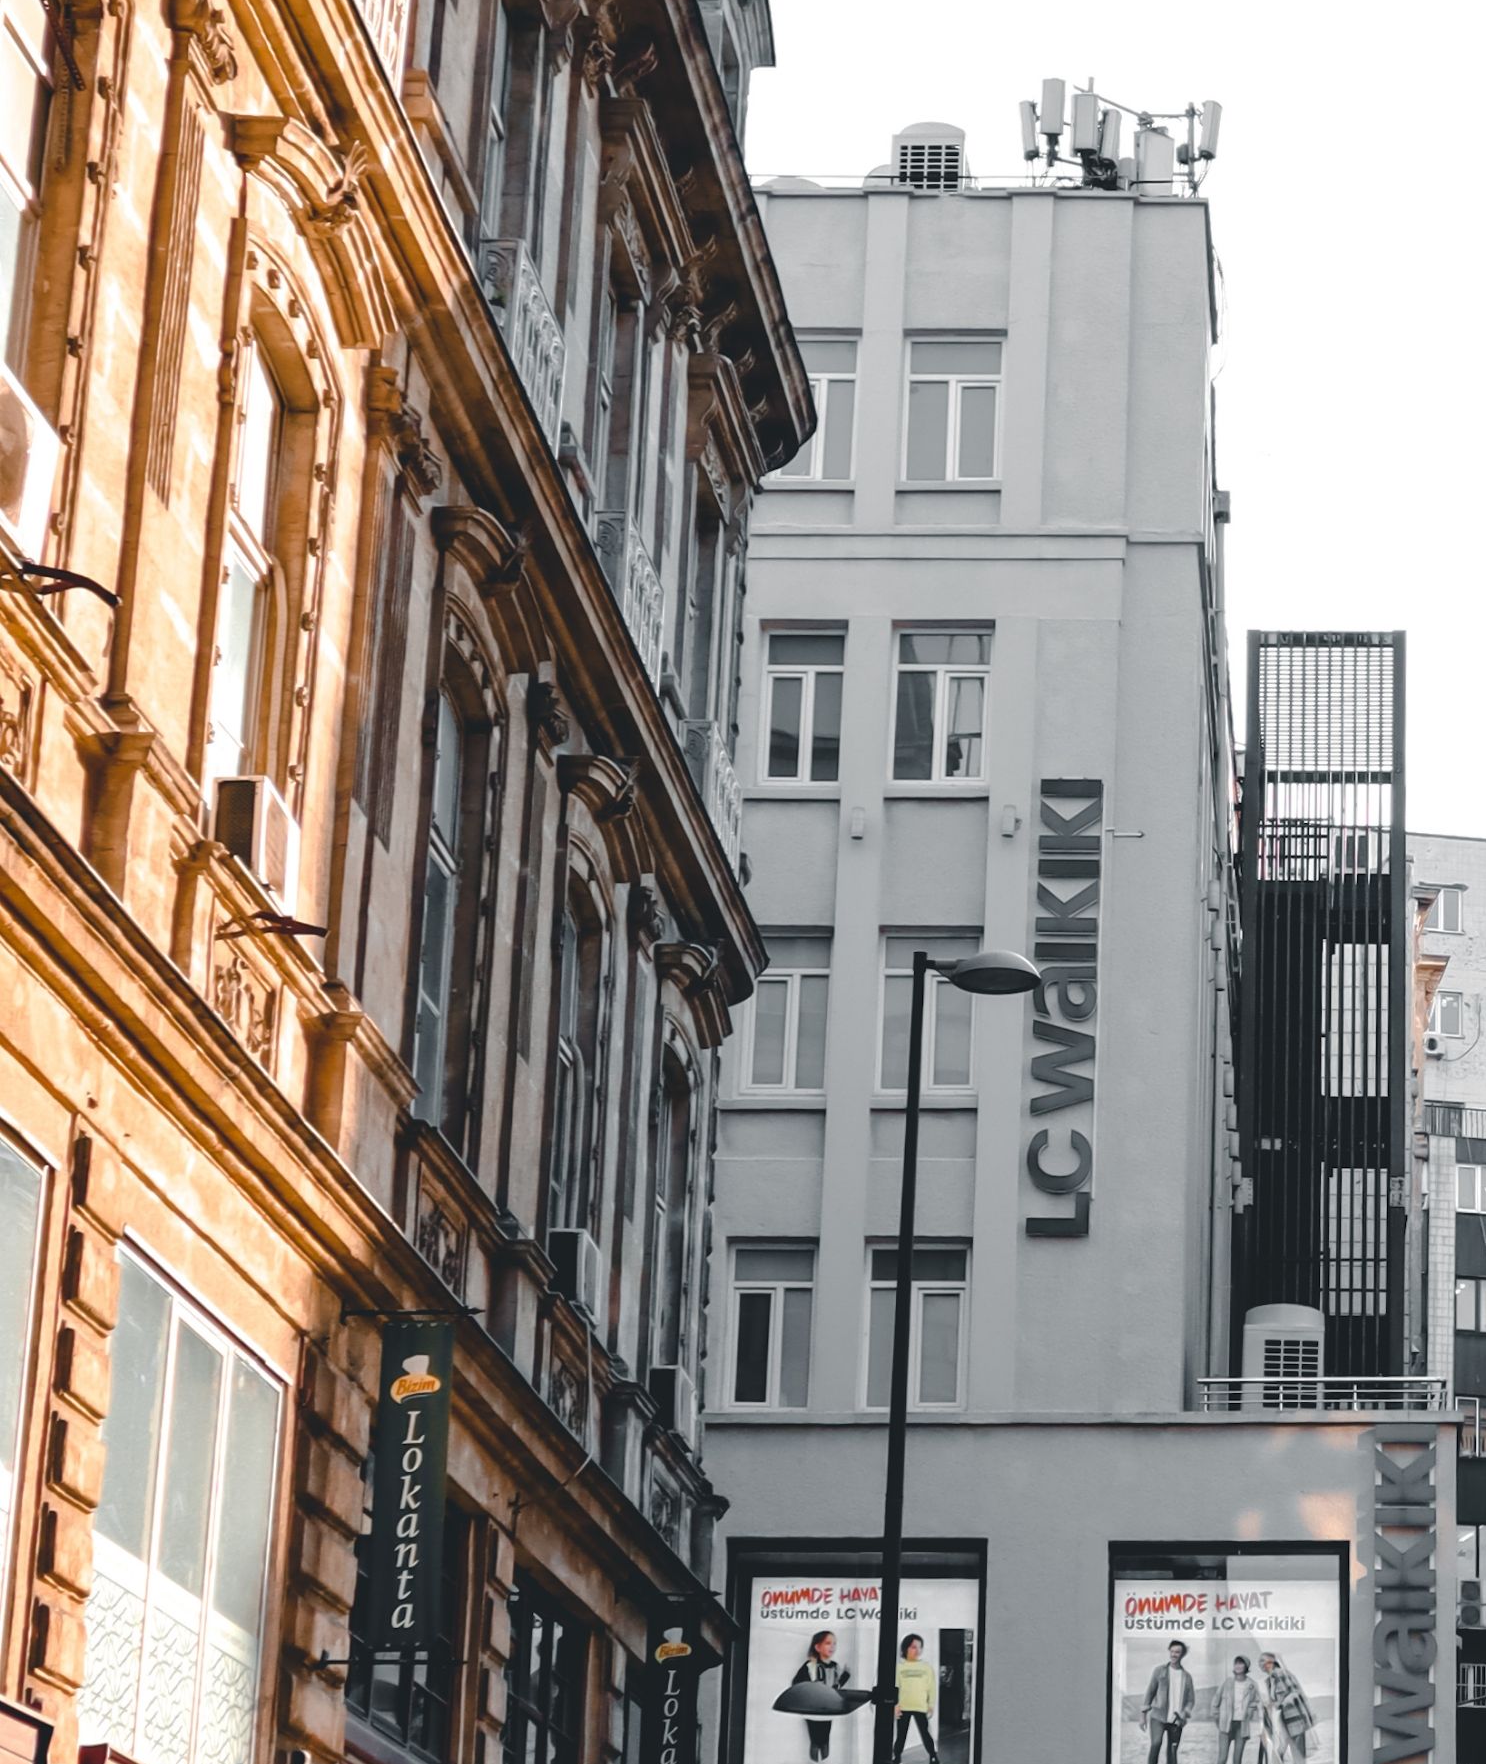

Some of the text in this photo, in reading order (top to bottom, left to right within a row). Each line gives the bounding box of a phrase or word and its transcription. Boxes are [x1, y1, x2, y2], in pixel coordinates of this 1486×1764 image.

[1024, 1127, 1093, 1237] LC
[396, 1379, 436, 1396] Bizim
[391, 1410, 425, 1630] Lokanta
[839, 1585, 883, 1604] HAYA
[1215, 1591, 1273, 1612] HAYAT
[760, 1606, 830, 1620] üstümde
[836, 1608, 856, 1620] LC
[1124, 1615, 1305, 1631] üstümde LC Waikiki
